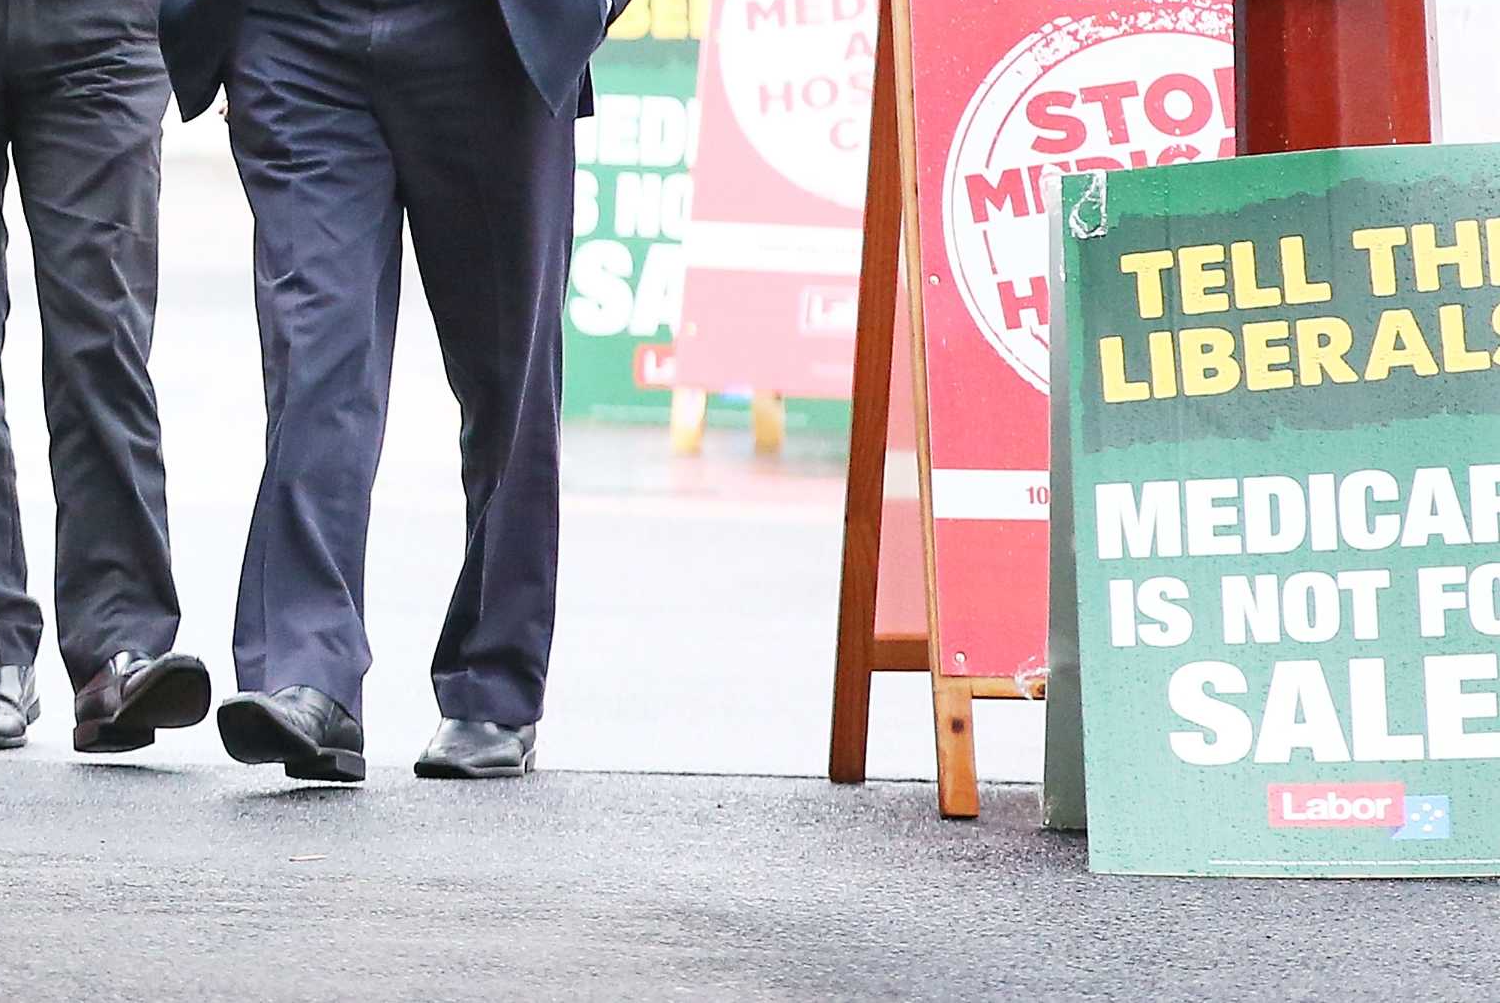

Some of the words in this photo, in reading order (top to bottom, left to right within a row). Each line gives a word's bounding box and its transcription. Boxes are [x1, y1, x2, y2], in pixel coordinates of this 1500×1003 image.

[1120, 235, 1332, 319] TELL
[1352, 218, 1500, 296] TH
[1100, 303, 1500, 403] LIBERAL
[1109, 576, 1194, 647] IS
[1221, 569, 1390, 644] NOT
[1168, 653, 1500, 766] SALE
[1282, 792, 1392, 820] Labor
